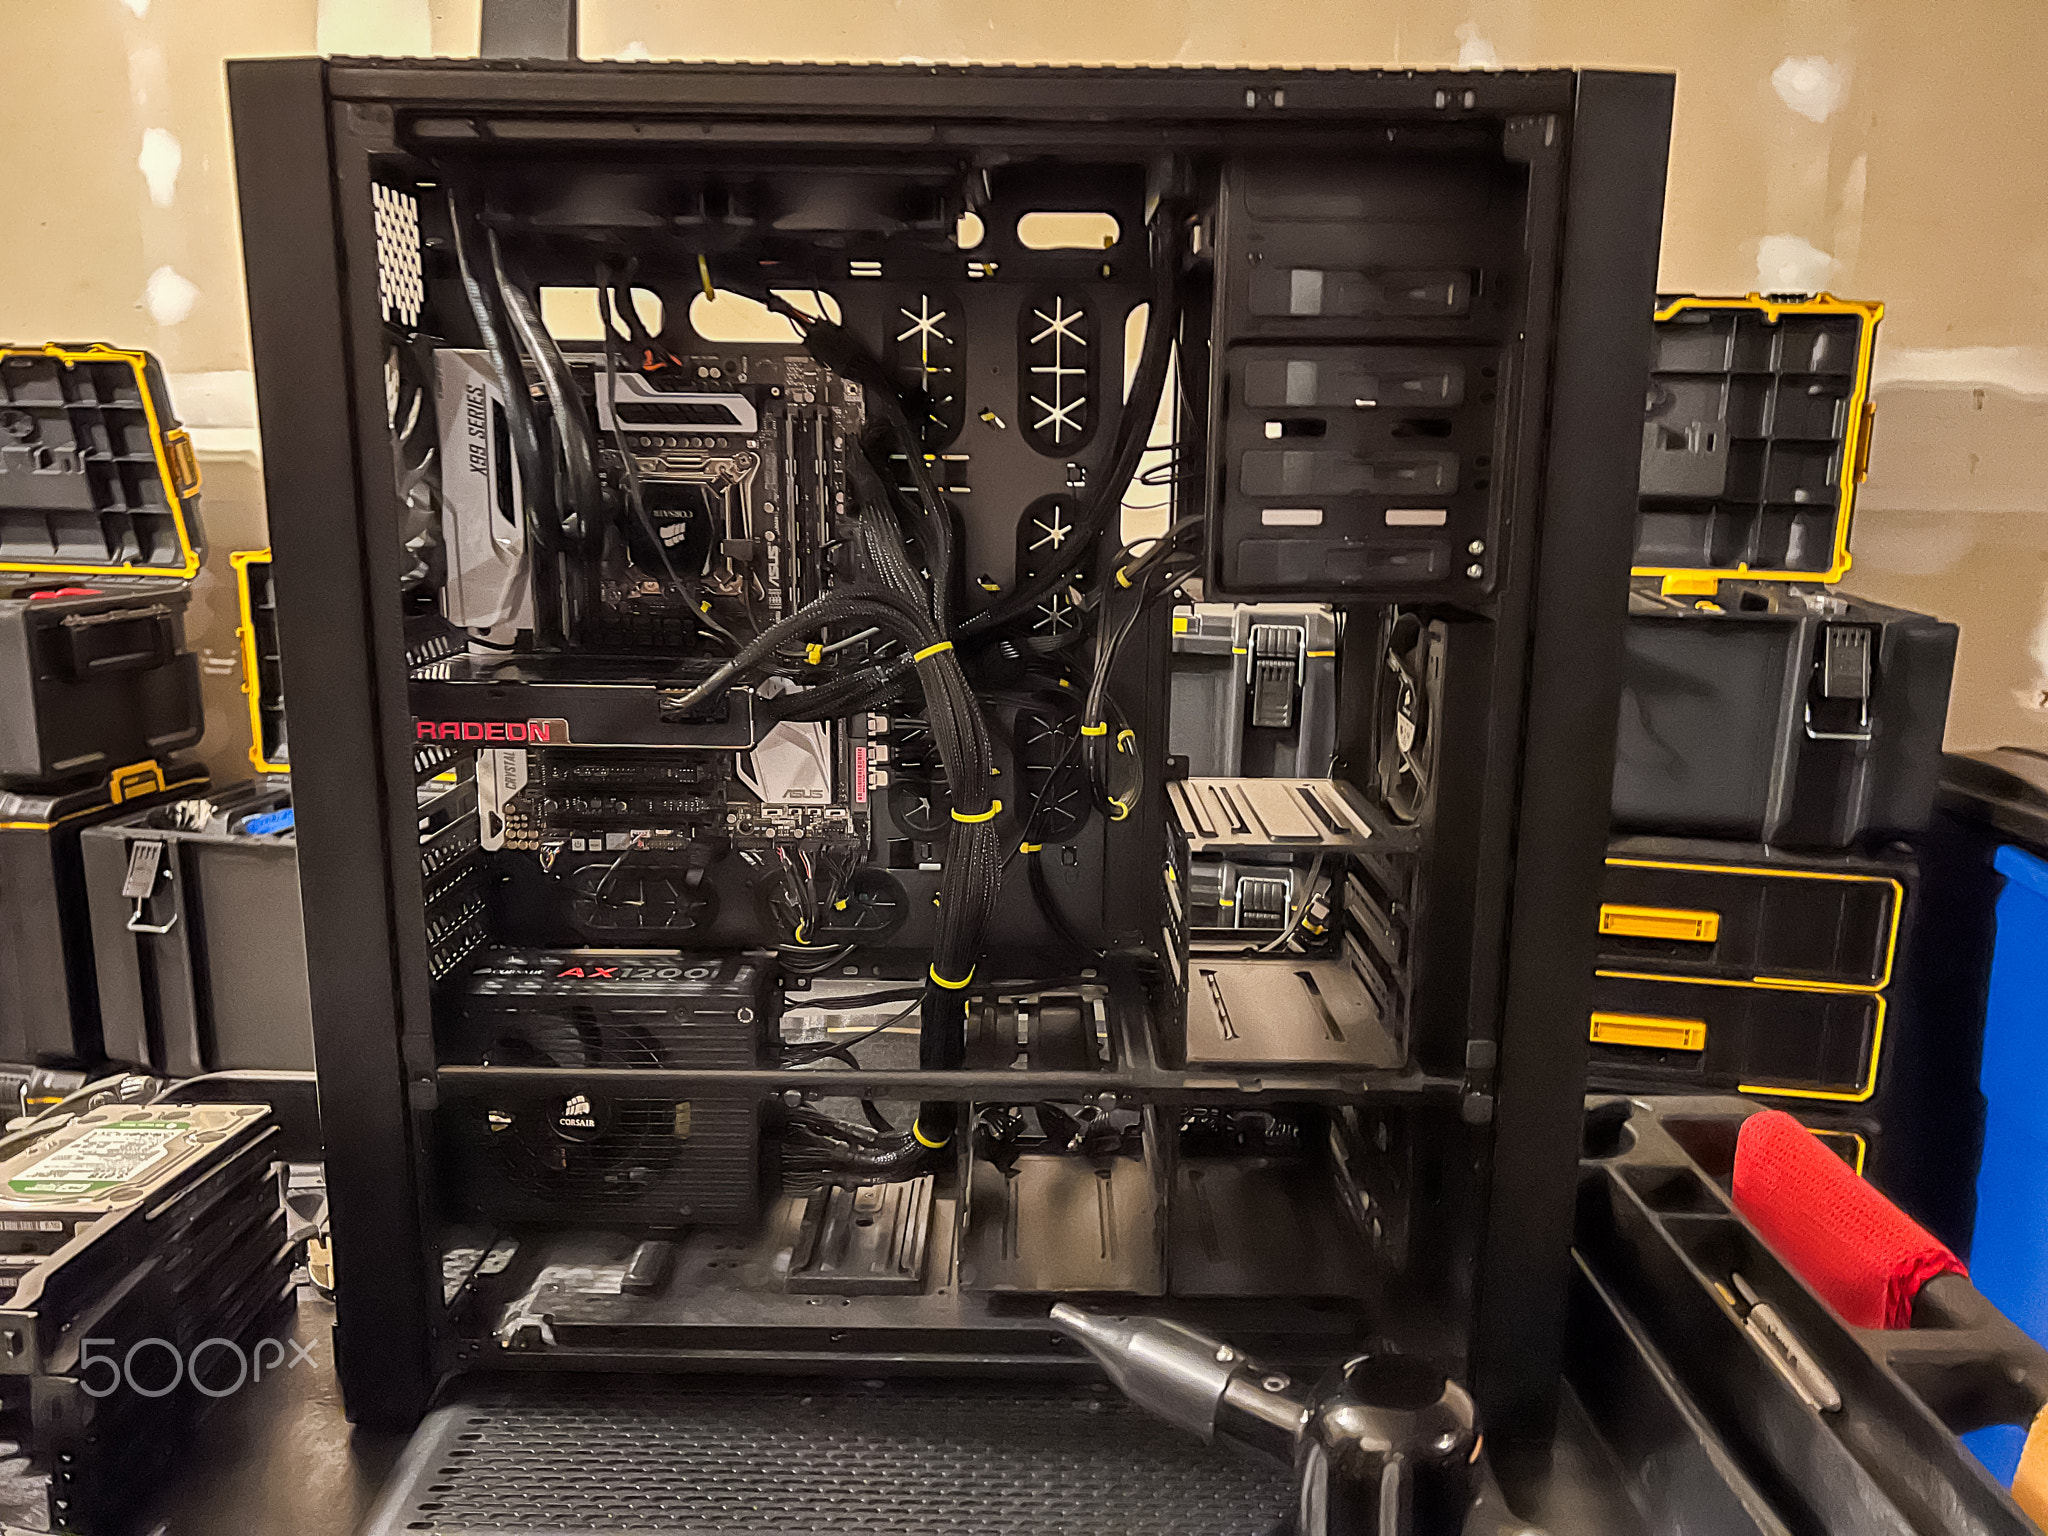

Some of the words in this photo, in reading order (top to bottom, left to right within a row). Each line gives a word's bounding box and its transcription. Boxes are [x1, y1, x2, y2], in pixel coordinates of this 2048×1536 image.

[466, 383, 487, 440] SERIES
[767, 545, 780, 588] ASUS
[416, 721, 550, 742] RADEON
[503, 751, 518, 791] CRYSTAL
[782, 789, 824, 799] ASUS
[557, 966, 721, 979] AX1200i
[559, 1118, 596, 1127] CORSAIR
